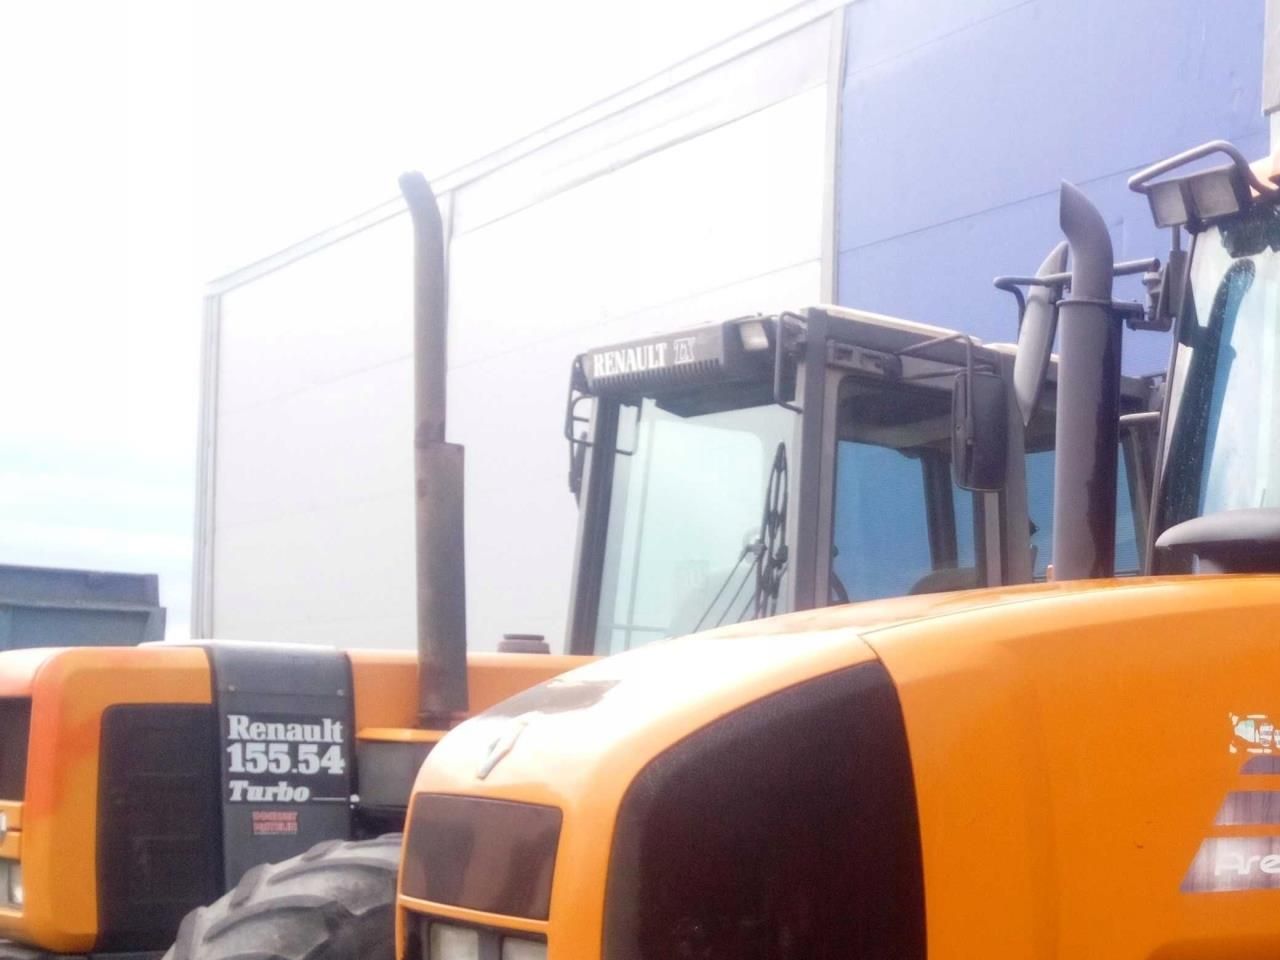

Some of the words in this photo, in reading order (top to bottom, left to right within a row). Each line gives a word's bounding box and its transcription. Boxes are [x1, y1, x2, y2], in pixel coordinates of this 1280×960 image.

[593, 342, 668, 377] RENAULT
[226, 714, 344, 743] Renault
[226, 742, 346, 774] 155.54
[229, 780, 311, 802] Turbo
